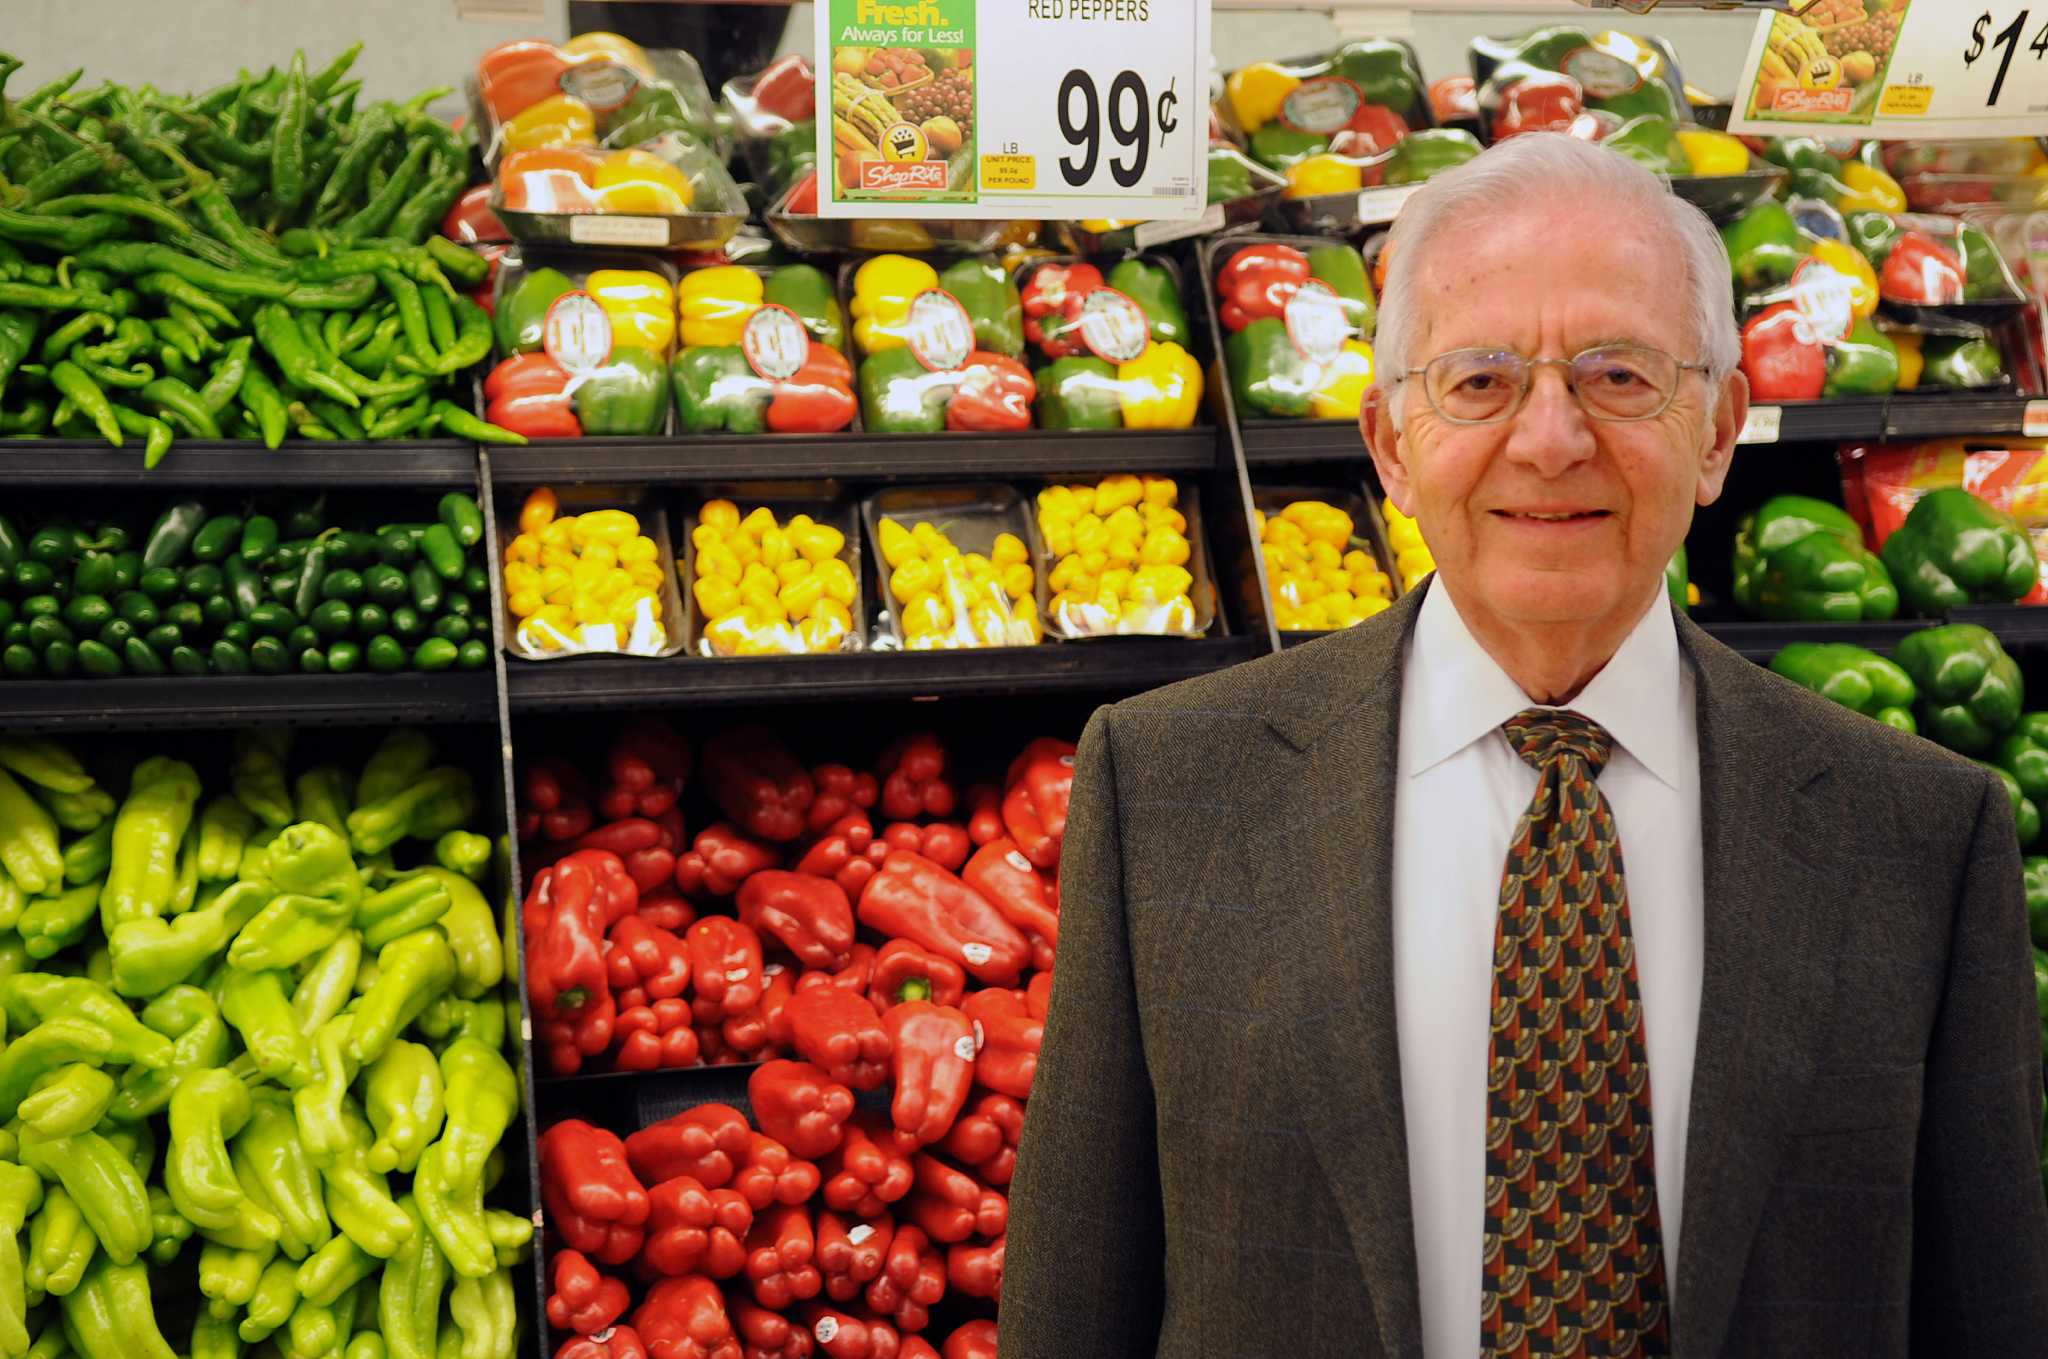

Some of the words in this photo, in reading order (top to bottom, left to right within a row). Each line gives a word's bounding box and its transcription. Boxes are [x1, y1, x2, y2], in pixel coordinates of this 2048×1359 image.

[856, 0, 950, 26] Fresh.
[1028, 0, 1064, 19] RED
[1069, 0, 1149, 21] PEPPERS
[841, 26, 897, 46] Always
[902, 27, 924, 42] for
[928, 28, 964, 43] Less!
[1002, 142, 1018, 154] LB
[986, 155, 1005, 163] UNIT
[1007, 155, 1031, 163] PRICE
[866, 164, 942, 191] ShopRite
